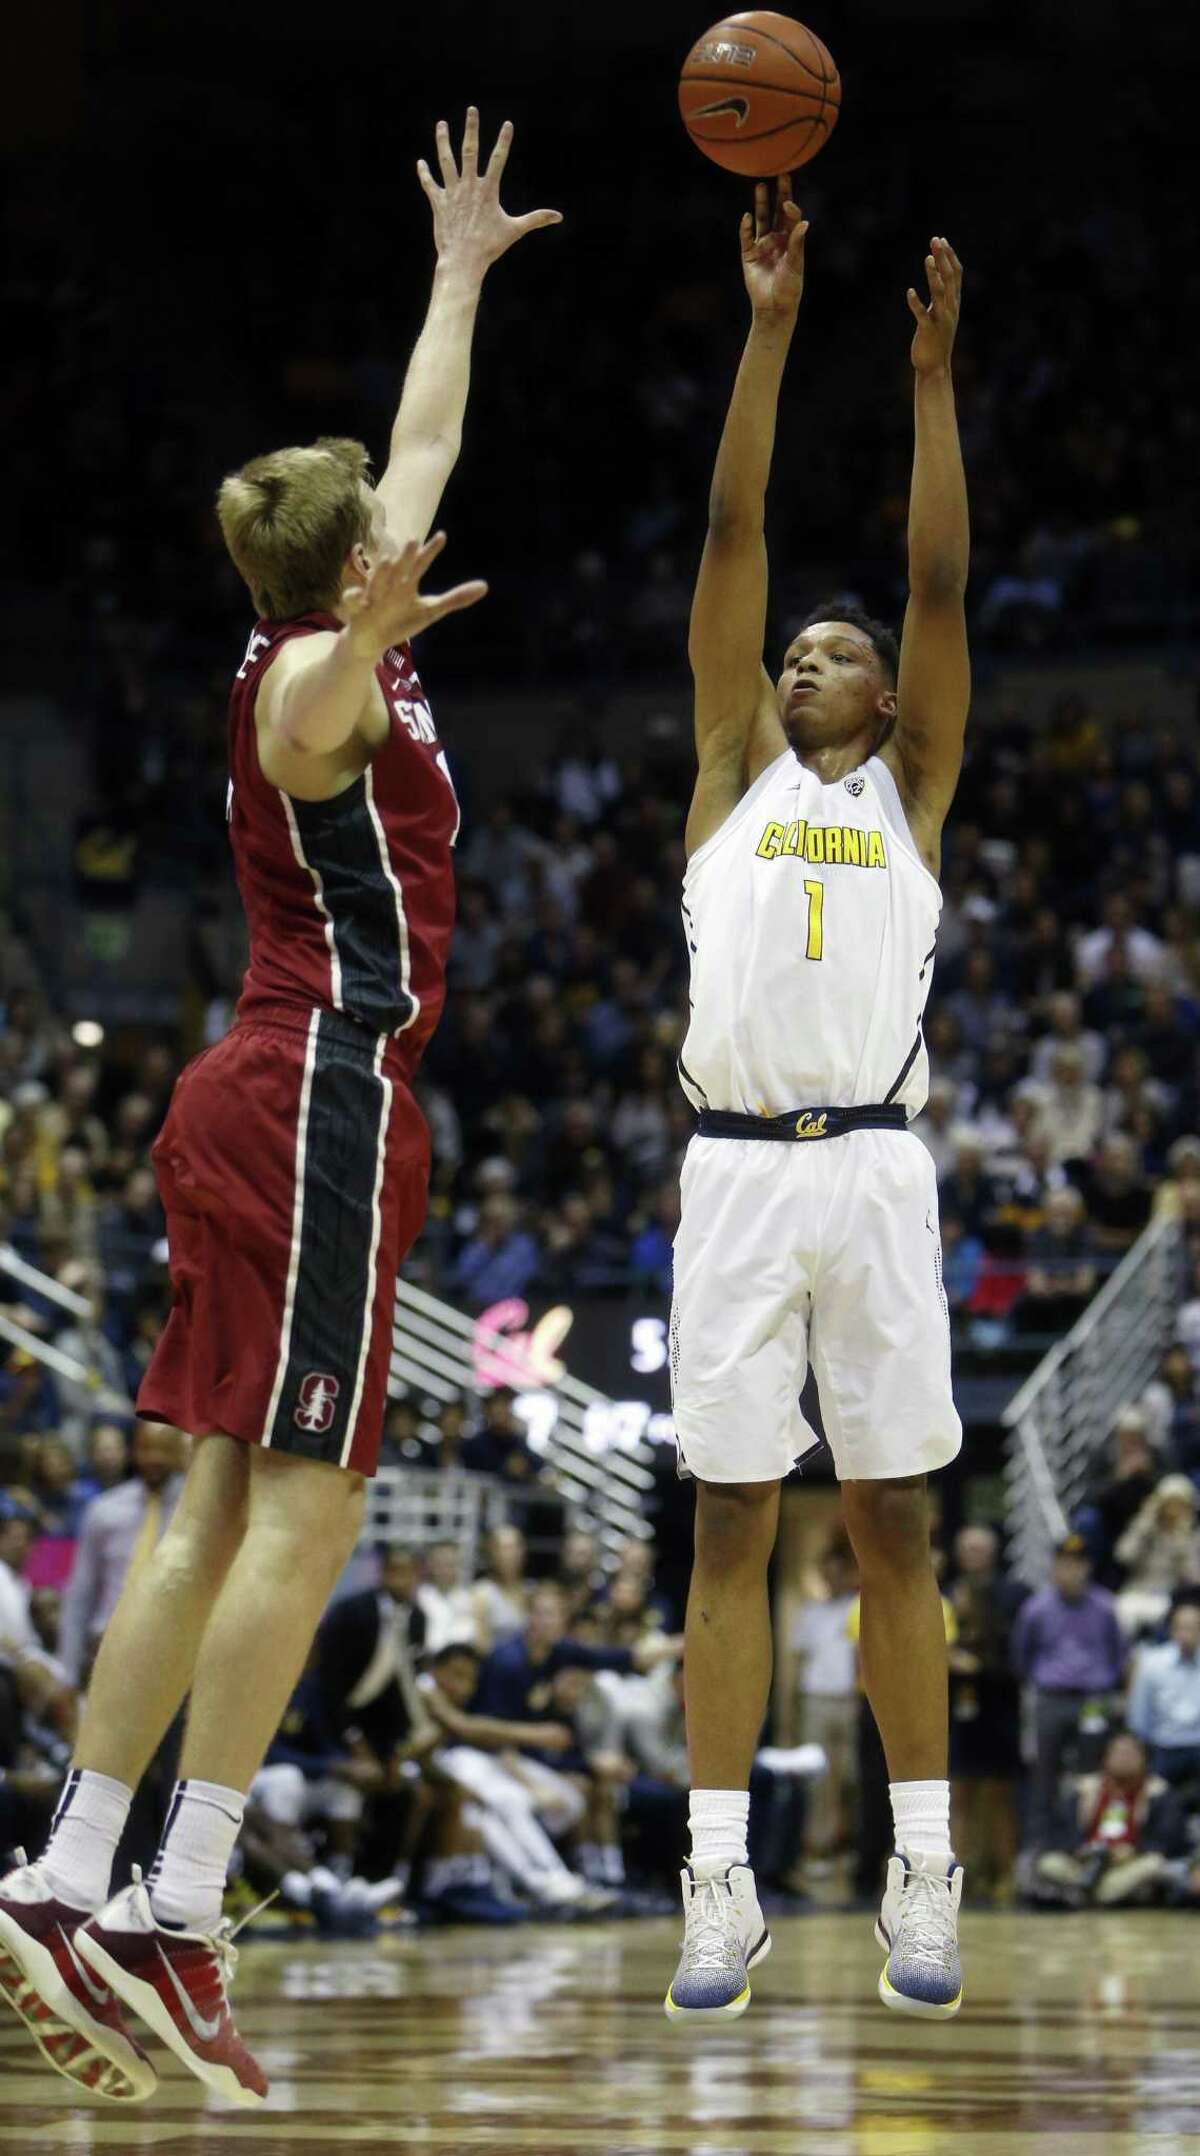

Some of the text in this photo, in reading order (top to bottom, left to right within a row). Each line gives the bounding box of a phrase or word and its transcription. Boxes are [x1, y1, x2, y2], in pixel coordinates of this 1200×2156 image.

[755, 819, 887, 869] CLIORNIA
[803, 879, 824, 961] 1
[795, 1112, 828, 1139] Cal
